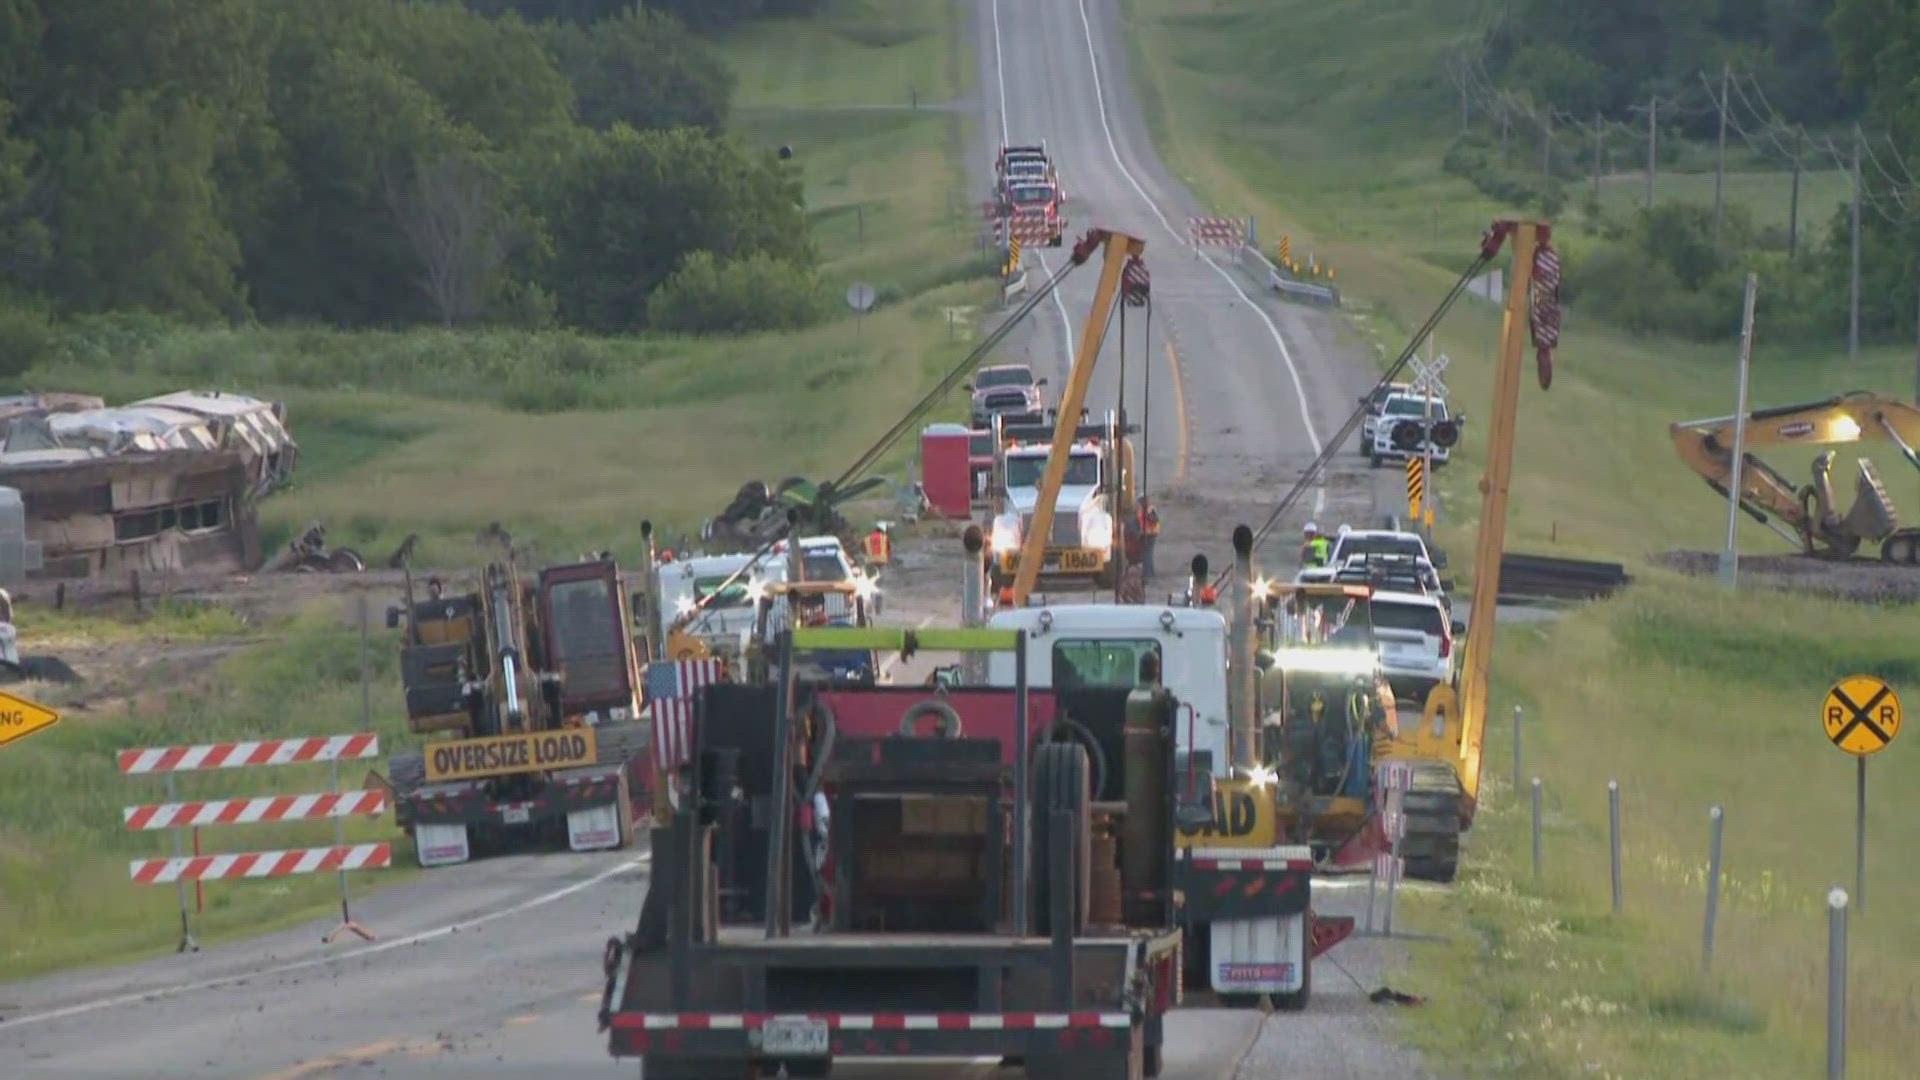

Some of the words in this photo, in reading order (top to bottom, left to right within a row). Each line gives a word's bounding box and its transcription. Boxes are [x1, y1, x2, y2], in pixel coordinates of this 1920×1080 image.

[1828, 706, 1843, 725] R
[1880, 705, 1894, 725] R
[433, 740, 530, 774] OVERSIZE
[532, 734, 587, 764] LOAD
